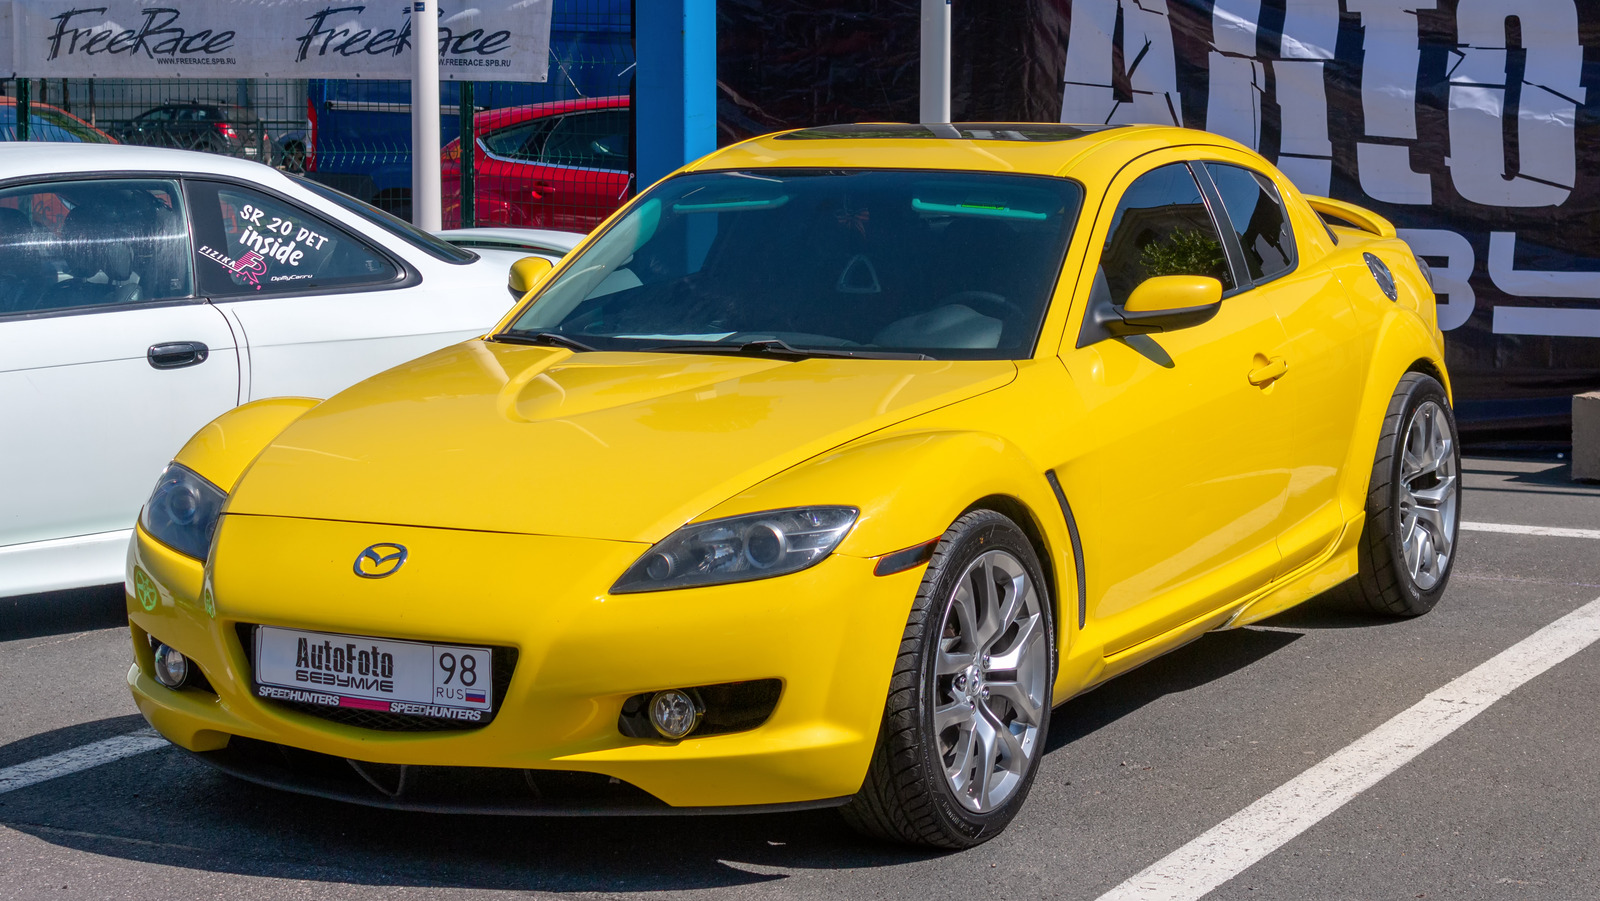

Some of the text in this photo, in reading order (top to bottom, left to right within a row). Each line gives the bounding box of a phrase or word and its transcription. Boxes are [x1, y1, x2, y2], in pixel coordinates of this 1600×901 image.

[47, 7, 236, 62] FreeRace
[157, 57, 237, 66] WWW.FREERACE.SPB.RU
[240, 204, 329, 251] SR 20 DET
[199, 245, 236, 268] FIZIKA
[239, 226, 304, 267] inside
[295, 637, 394, 679] AutoFoto
[439, 652, 477, 687] 98
[258, 686, 482, 721] SPEEDHUNTERS SPEEDHUNTERS
[436, 687, 464, 700] RUS
